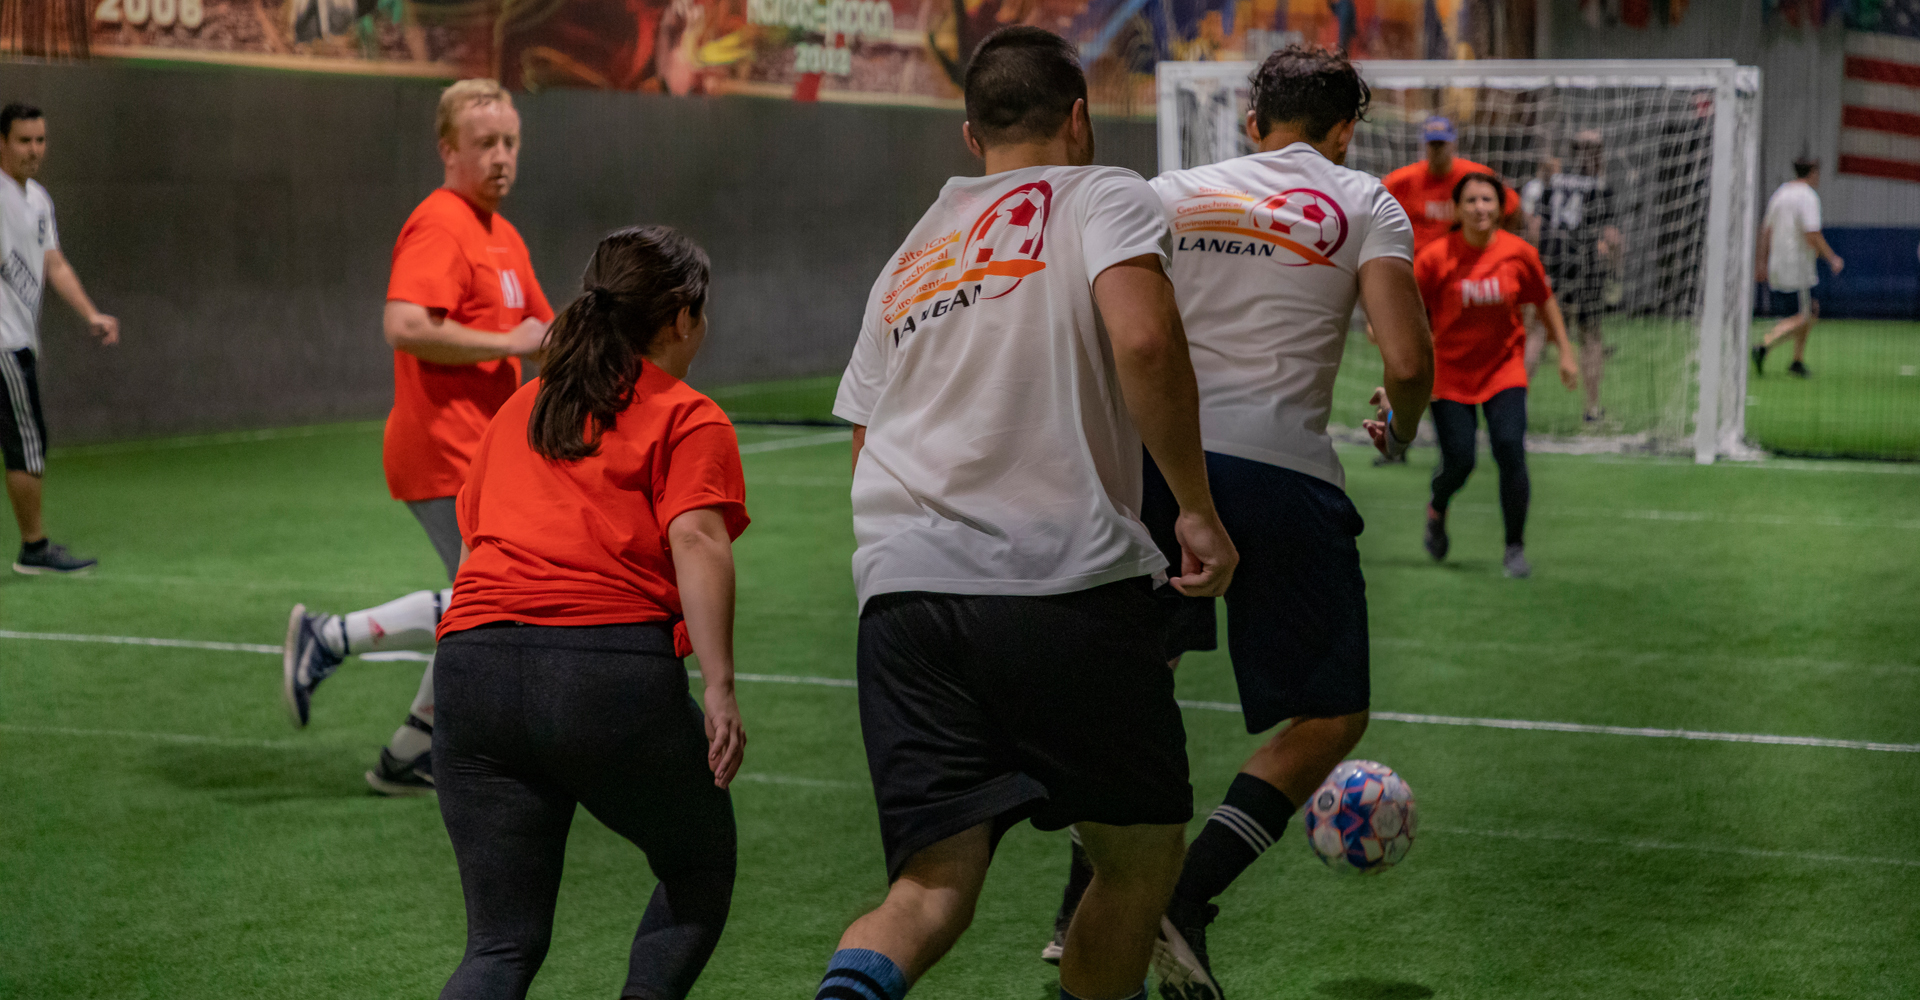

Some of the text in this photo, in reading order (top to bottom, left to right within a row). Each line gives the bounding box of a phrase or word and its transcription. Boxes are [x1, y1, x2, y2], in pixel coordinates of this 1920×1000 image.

[1174, 218, 1240, 231] Environmental
[1178, 236, 1276, 257] LANGAN
[883, 272, 948, 325] Eviromental
